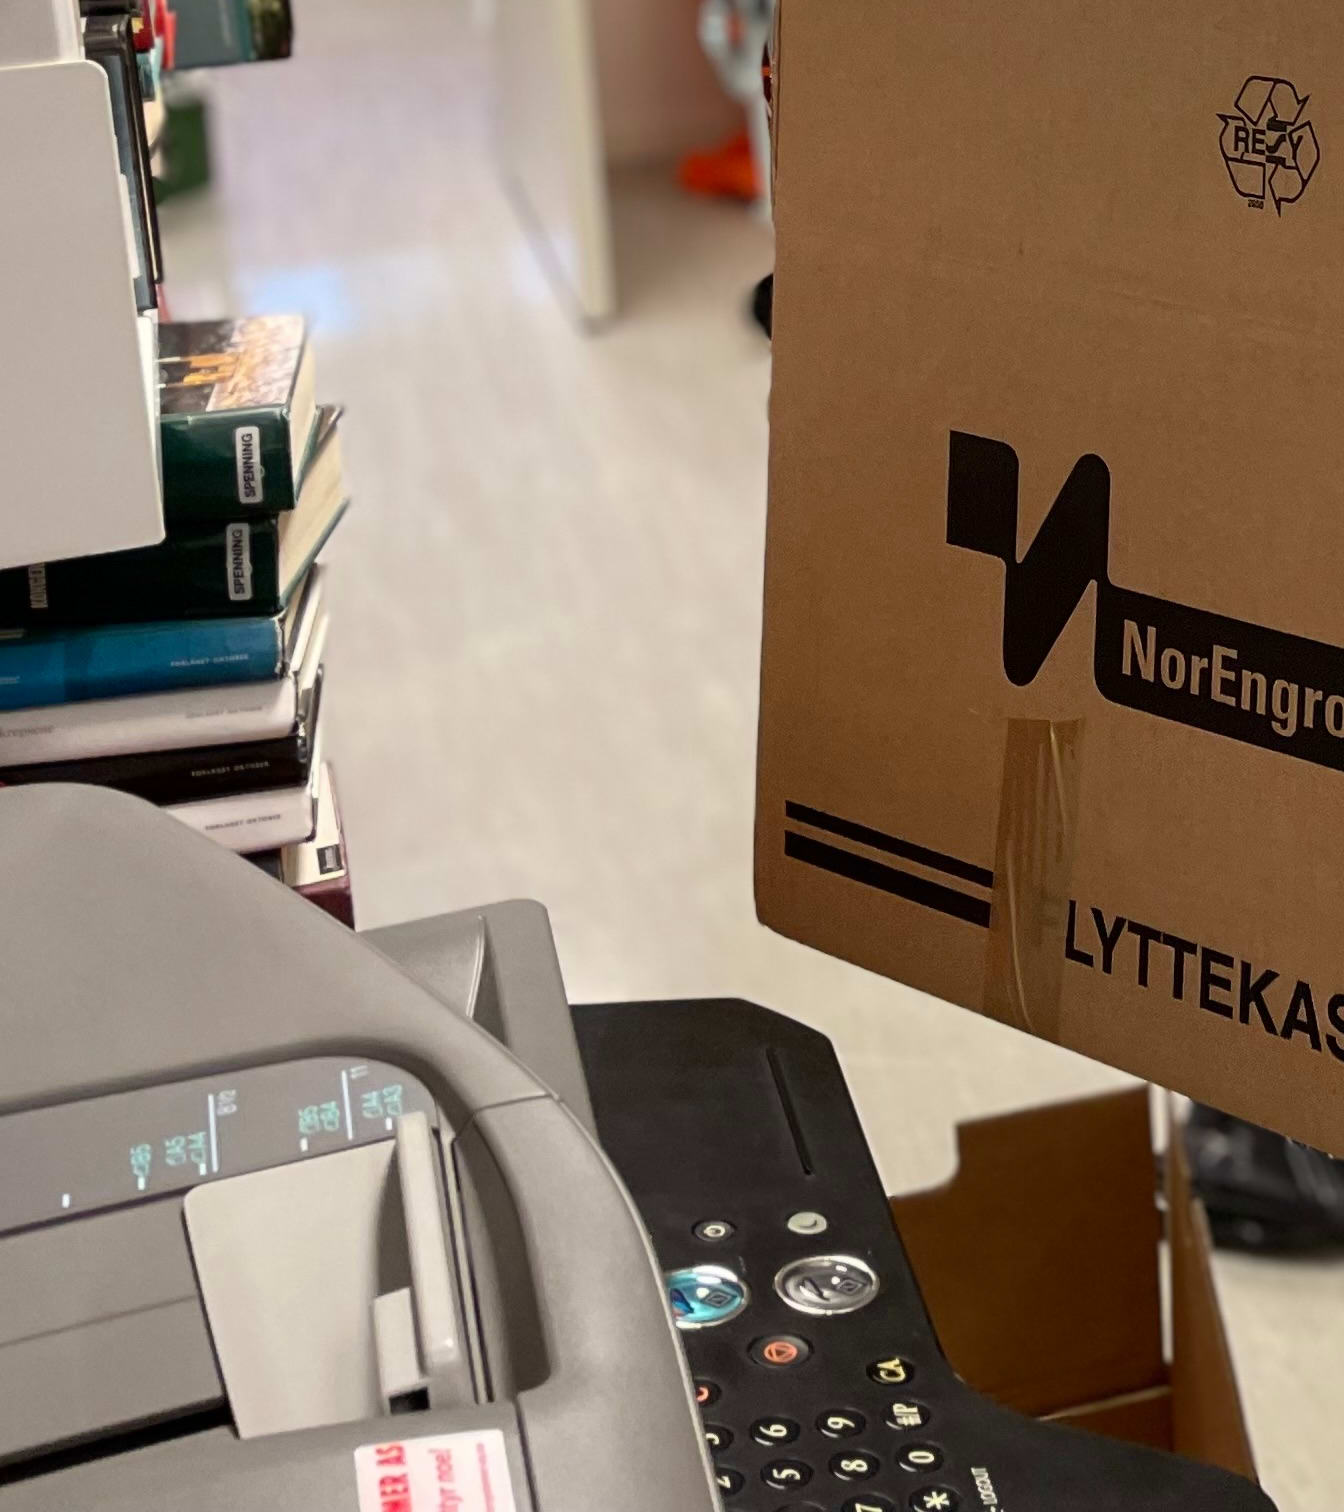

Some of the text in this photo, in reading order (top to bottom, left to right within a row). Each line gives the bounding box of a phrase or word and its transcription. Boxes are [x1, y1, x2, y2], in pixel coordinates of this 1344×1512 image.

[241, 433, 256, 498] SPENNING
[232, 529, 246, 595] SPENNING
[877, 1358, 905, 1382] CA
[760, 1424, 787, 1437] 6
[828, 1417, 855, 1429] 9
[772, 1469, 800, 1480] 5
[840, 1459, 868, 1473] 8
[971, 1467, 998, 1505] LOGOUT
